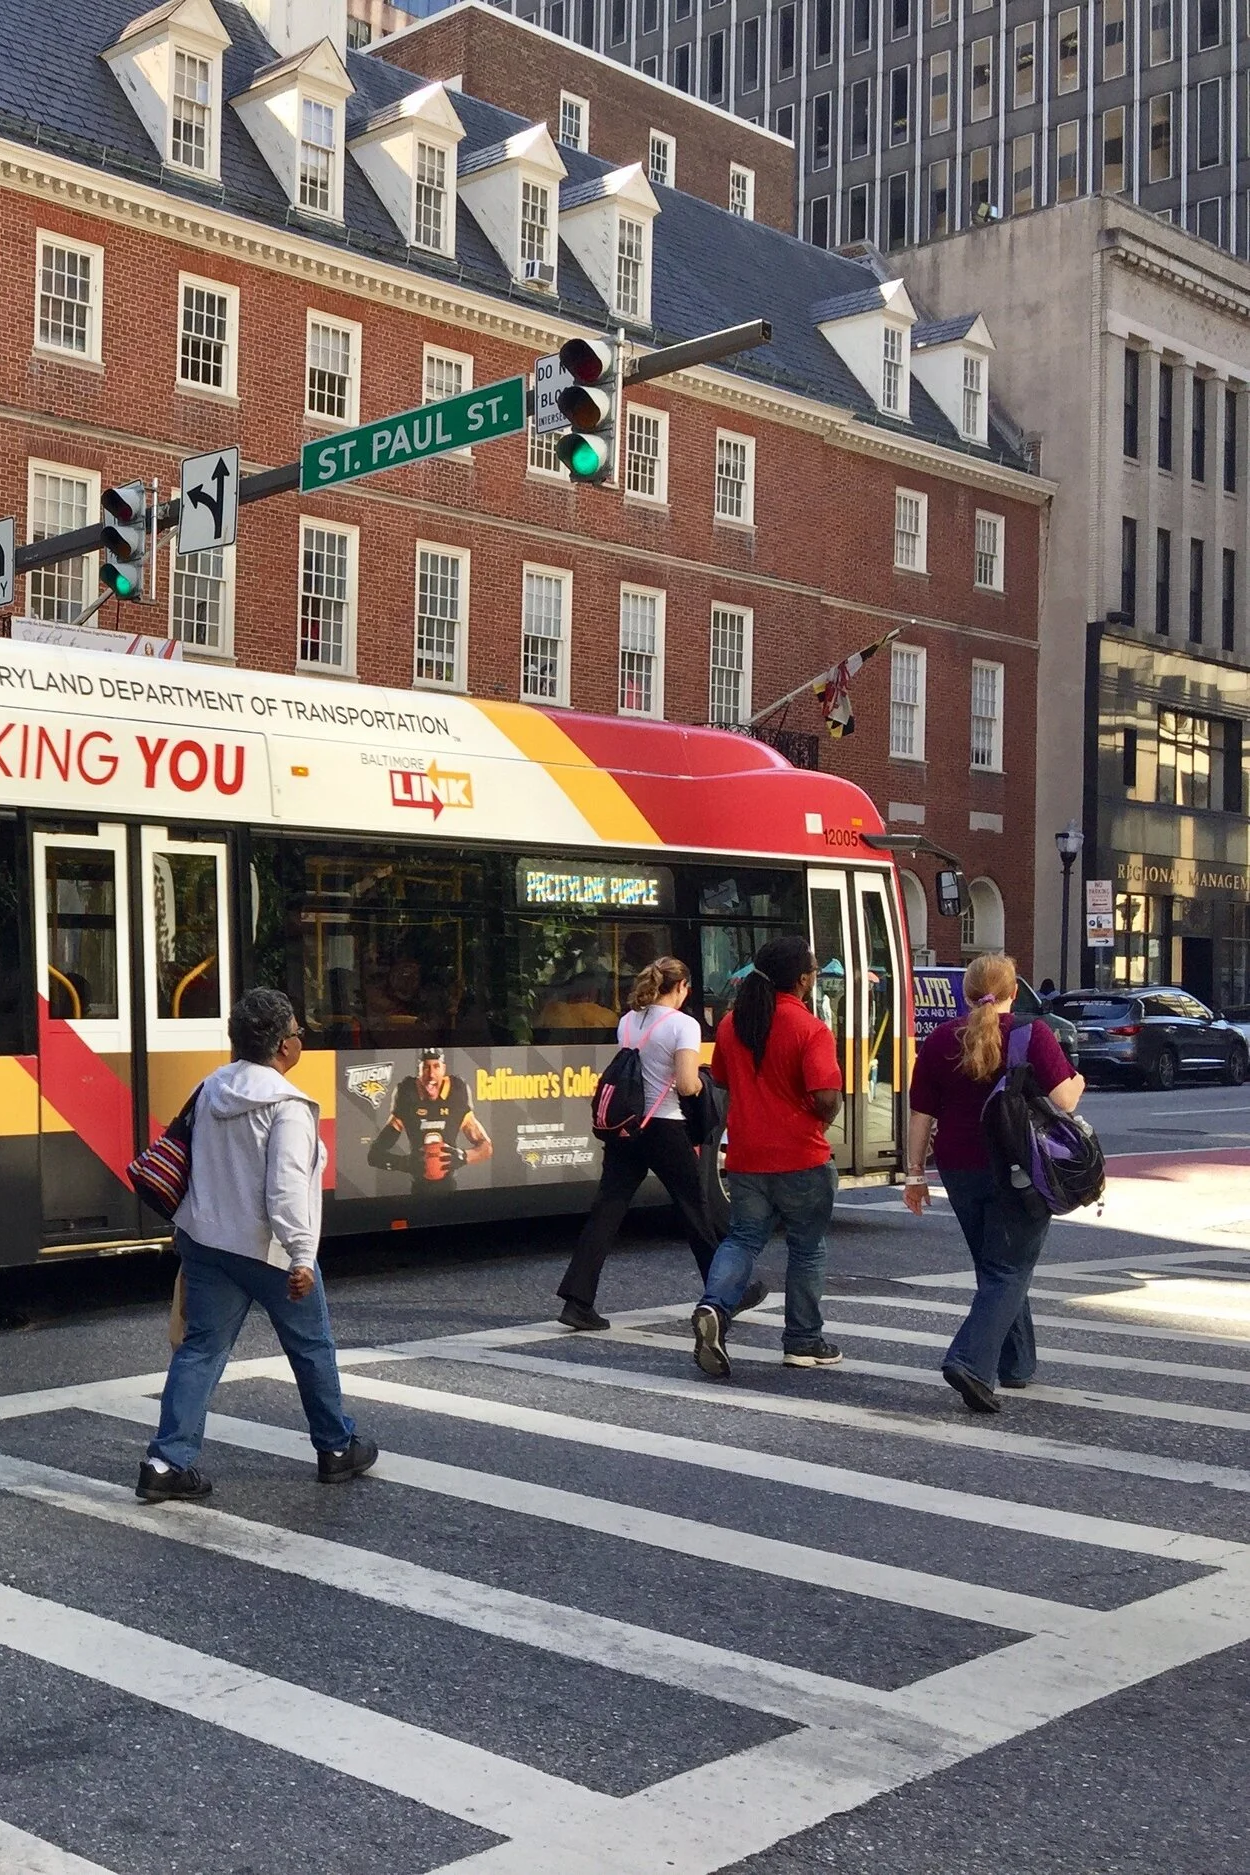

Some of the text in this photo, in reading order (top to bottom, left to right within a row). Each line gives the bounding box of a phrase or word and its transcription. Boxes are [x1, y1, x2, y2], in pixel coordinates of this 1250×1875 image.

[538, 364, 553, 381] DO
[541, 389, 562, 407] BLO
[539, 412, 566, 427] INTERSE
[317, 396, 509, 480] ST. PAUL ST.
[99, 678, 244, 713] DEPARTMENT
[250, 696, 279, 717] OF
[281, 699, 450, 736] TRANSPORTATION
[134, 735, 245, 795] YOU
[360, 752, 426, 771] BALTIMORE
[391, 772, 473, 808] LINK
[822, 828, 859, 848] 12005
[1117, 863, 1183, 885] REGIONAL
[610, 877, 659, 906] PURPLE
[914, 976, 956, 1008] LITE
[914, 1008, 958, 1018] OCK AND KEY
[476, 1065, 602, 1101] Baltimore's Colle
